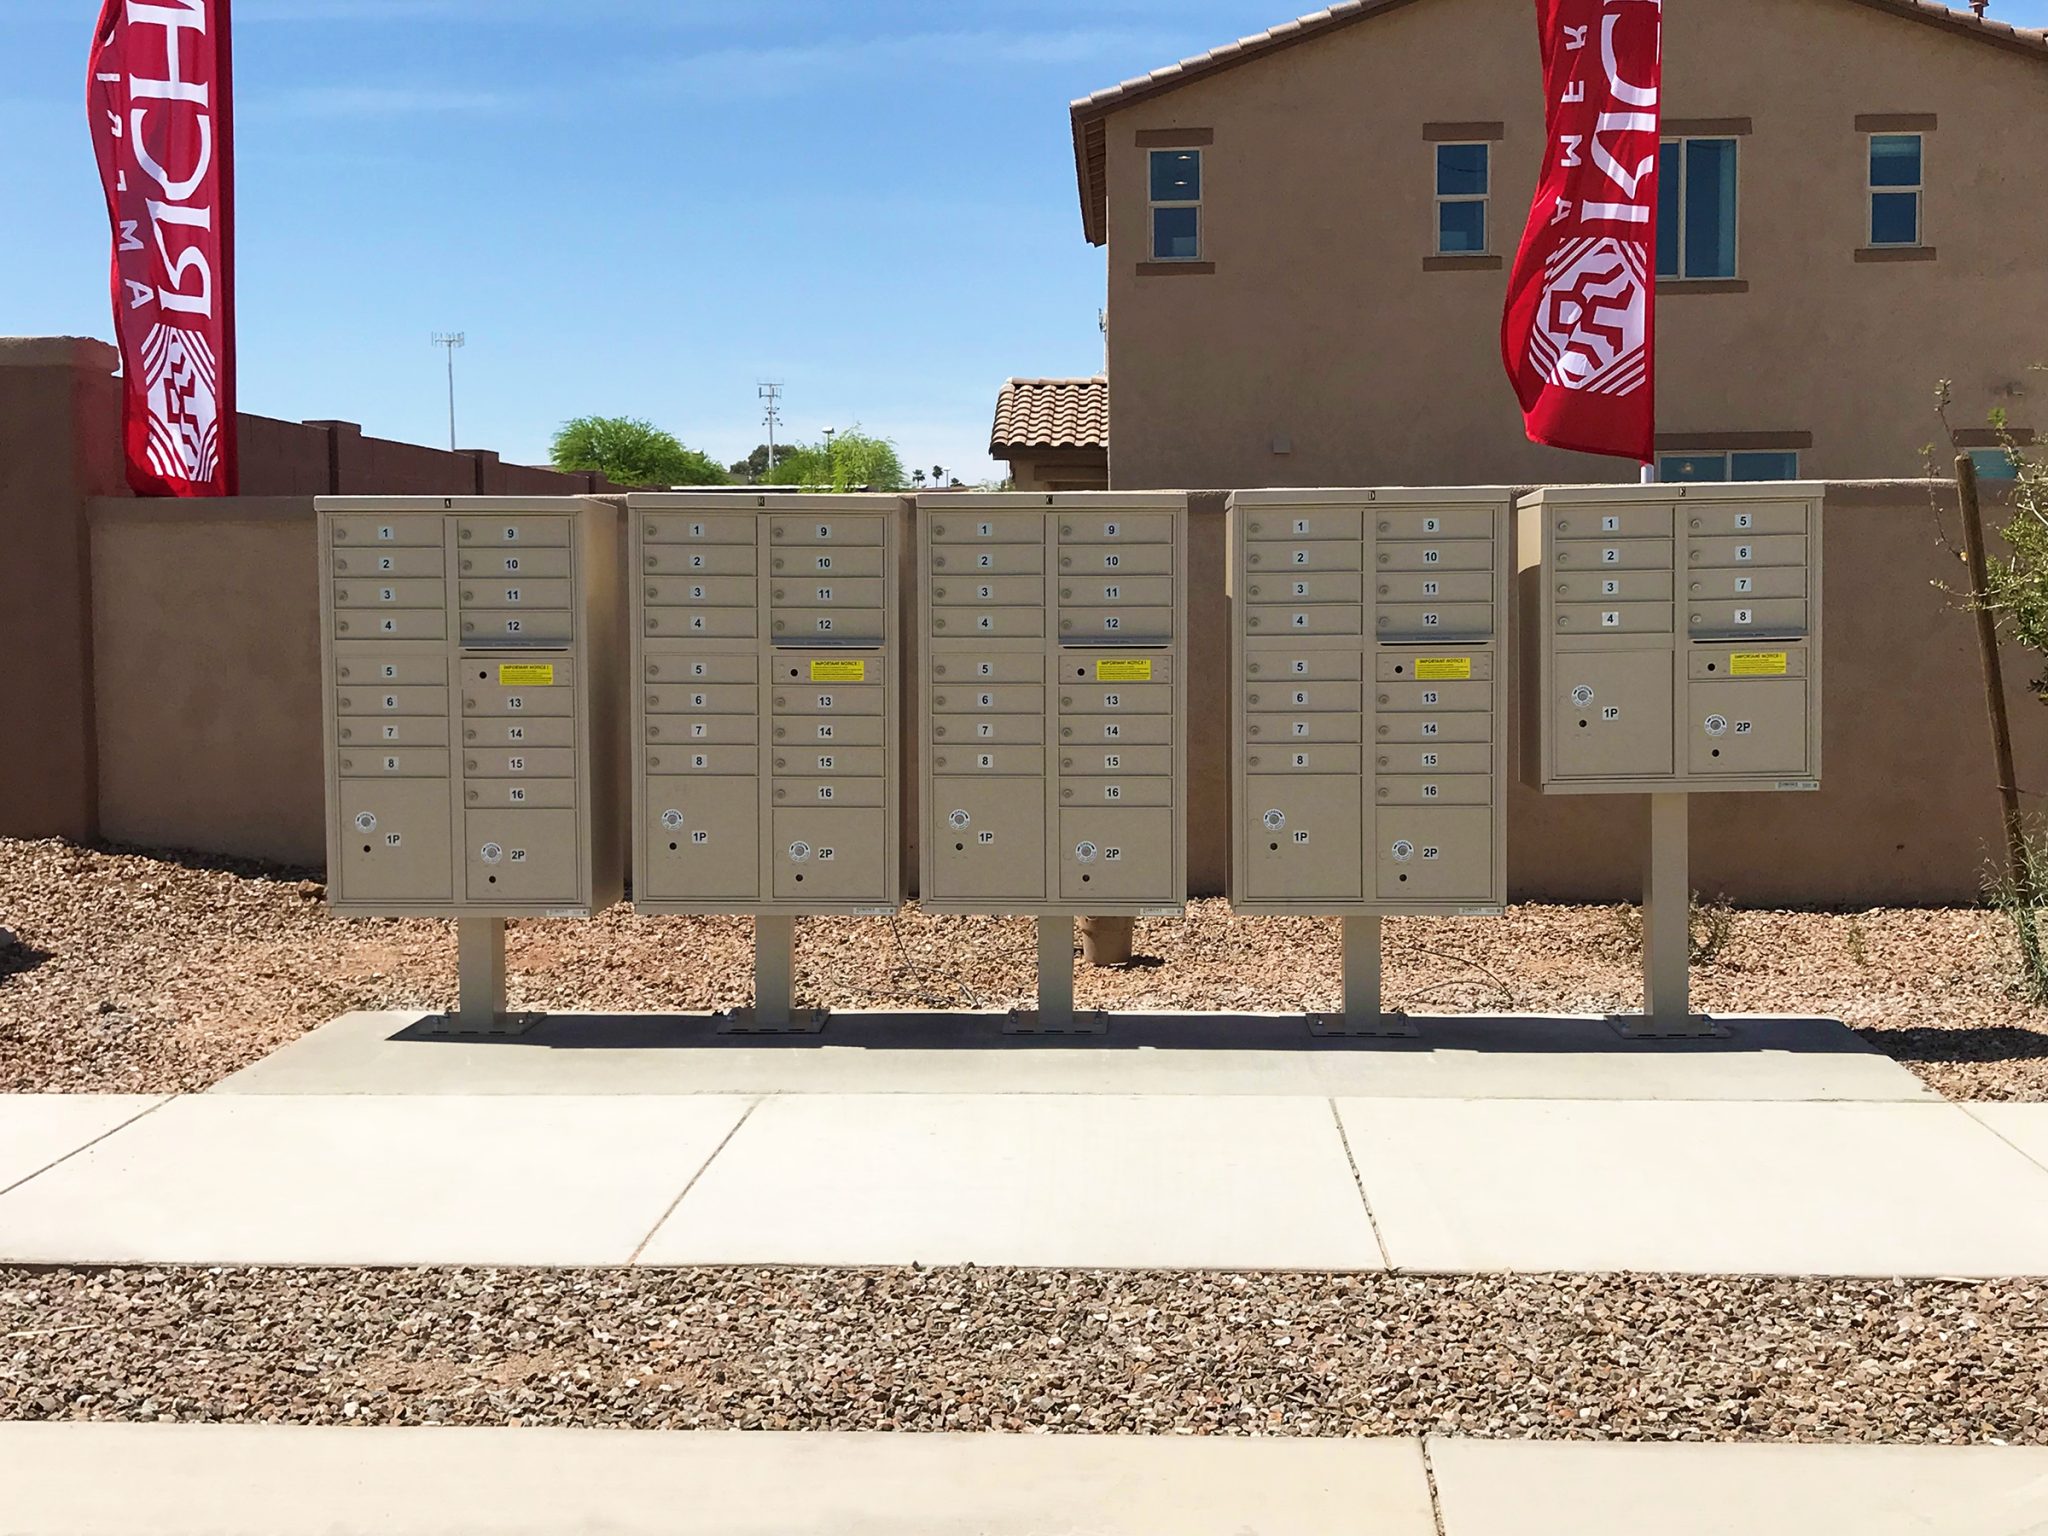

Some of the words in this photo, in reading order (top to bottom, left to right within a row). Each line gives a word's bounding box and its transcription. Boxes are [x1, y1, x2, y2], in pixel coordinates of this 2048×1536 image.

[1297, 521, 1303, 532] 1
[1427, 520, 1435, 531] 9
[1607, 518, 1613, 529] 1
[1739, 516, 1747, 526] 5
[382, 528, 389, 538] 1
[507, 528, 515, 539] 9
[693, 525, 700, 535] 1
[820, 526, 828, 537] 9
[981, 524, 987, 535] 1
[1108, 524, 1116, 535] 9
[1297, 552, 1304, 563] 2
[1424, 551, 1438, 562] 10
[1607, 550, 1615, 561] 2
[1739, 547, 1747, 558] 6
[382, 559, 390, 569] 2
[505, 559, 519, 570] 10
[693, 556, 701, 567] 2
[817, 557, 831, 568] 10
[981, 555, 988, 566] 2
[1105, 556, 1119, 566] 10
[1297, 584, 1304, 594] 3
[1424, 583, 1436, 593] 11
[1607, 582, 1614, 592] 3
[1739, 579, 1747, 590] 7
[384, 589, 391, 600] 3
[506, 590, 519, 600] 11
[694, 587, 702, 598] 3
[818, 588, 830, 599] 11
[981, 587, 989, 597] 3
[1106, 587, 1118, 598] 11
[1296, 615, 1304, 625] 4
[1424, 614, 1437, 625] 12
[1606, 613, 1614, 624] 4
[1739, 611, 1747, 621] 8
[384, 620, 392, 631] 4
[507, 621, 520, 631] 12
[694, 618, 702, 628] 4
[818, 619, 832, 630] 12
[981, 617, 989, 628] 4
[1105, 618, 1119, 629] 12
[386, 666, 393, 677] 5
[695, 664, 703, 675] 5
[981, 664, 989, 674] 5
[1296, 662, 1304, 672] 5
[386, 696, 394, 707] 6
[509, 697, 522, 708] 13
[695, 695, 702, 705] 6
[819, 696, 832, 706] 13
[981, 694, 989, 705] 6
[1105, 695, 1119, 705] 13
[1296, 692, 1304, 703] 6
[1423, 692, 1437, 703] 13
[1604, 708, 1618, 718] 1P
[387, 727, 394, 737] 7
[695, 725, 703, 735] 7
[819, 727, 832, 737] 14
[982, 725, 989, 736] 7
[1106, 726, 1119, 736] 14
[1296, 724, 1304, 734] 7
[1423, 724, 1437, 734] 14
[1736, 722, 1751, 732] 2P
[510, 728, 523, 738] 14
[388, 758, 395, 769] 8
[510, 758, 523, 769] 15
[695, 756, 703, 766] 8
[819, 757, 832, 767] 15
[981, 756, 989, 766] 8
[1106, 756, 1119, 767] 15
[1296, 755, 1304, 765] 8
[1423, 754, 1437, 765] 15
[511, 789, 524, 800] 16
[819, 787, 832, 798] 16
[1106, 787, 1119, 797] 16
[1424, 785, 1437, 796] 16
[387, 834, 401, 844] 1P
[693, 832, 707, 842] 1P
[979, 832, 993, 842] 1P
[1294, 832, 1308, 842] 1P
[511, 850, 525, 860] 2P
[819, 848, 833, 859] 2P
[1105, 848, 1120, 859] 2P
[1423, 847, 1438, 858] 2P
